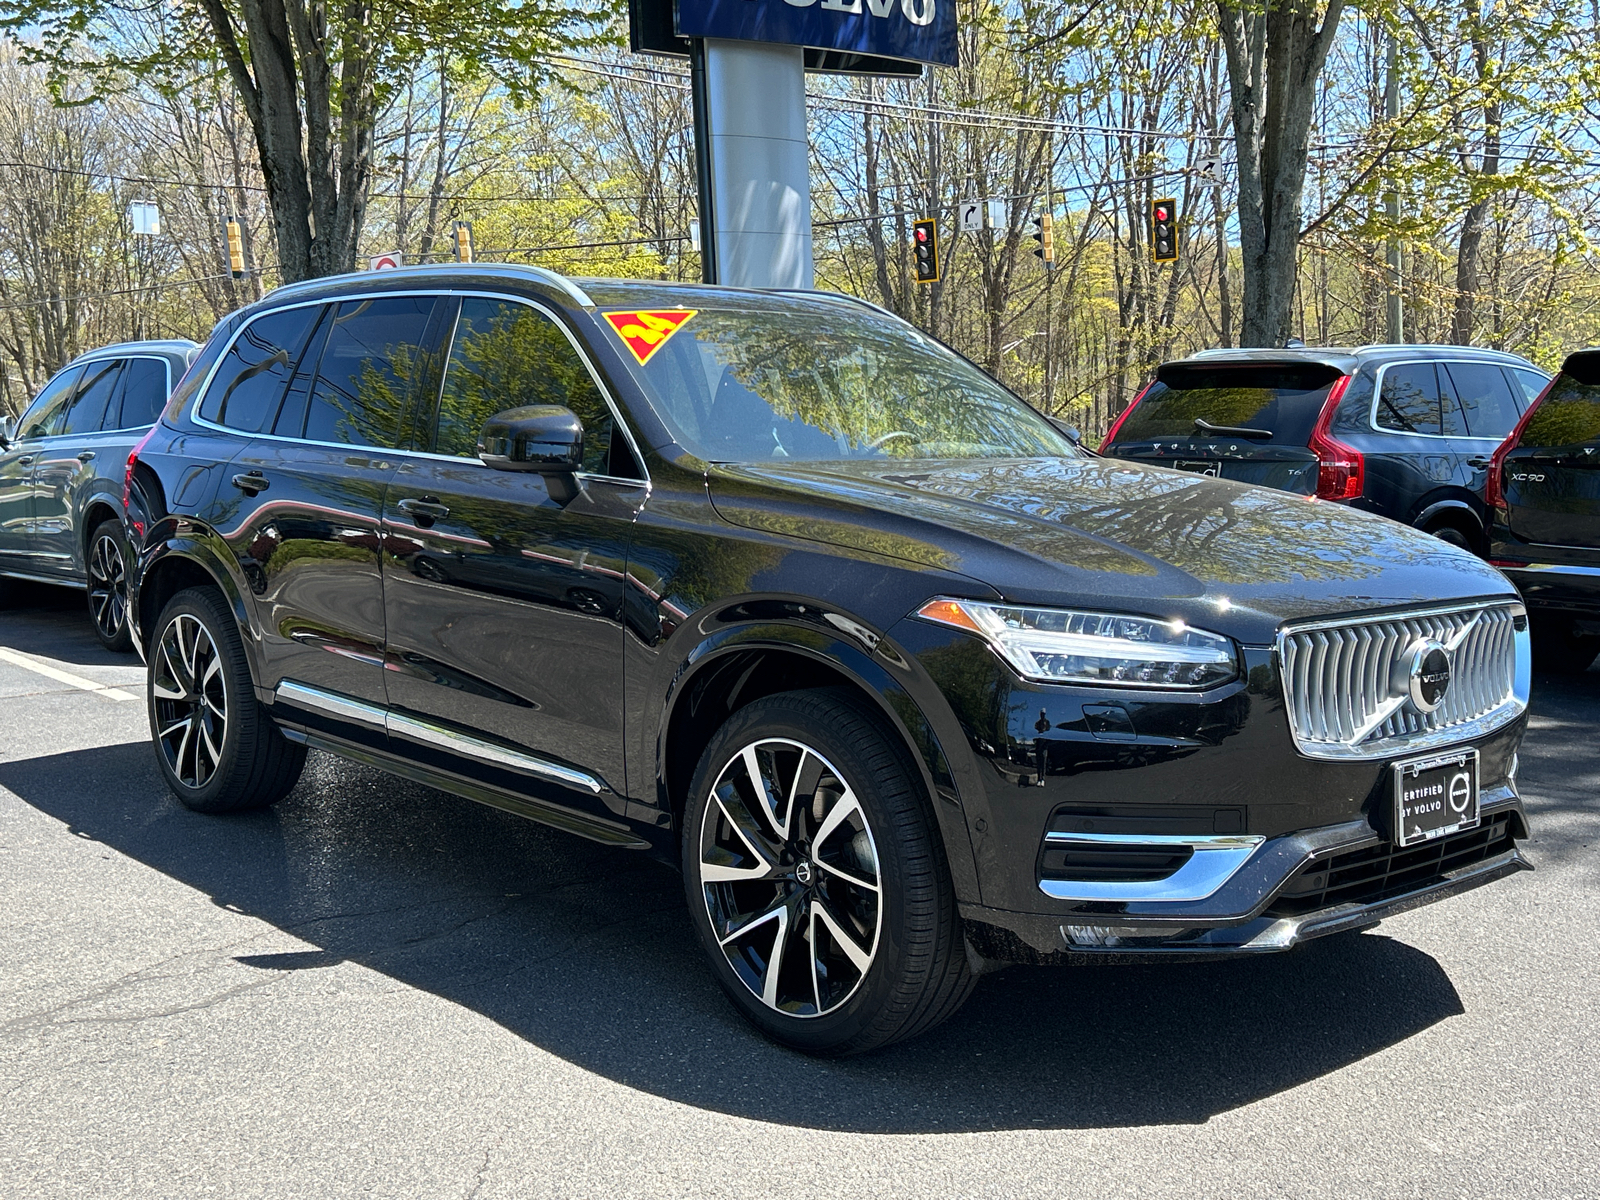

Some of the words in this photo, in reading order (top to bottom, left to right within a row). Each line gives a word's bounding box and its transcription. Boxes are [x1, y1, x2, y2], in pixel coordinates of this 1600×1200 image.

[964, 222, 979, 230] ONLY
[620, 313, 677, 345] 24
[1153, 443, 1238, 452] VOLVO
[1511, 473, 1546, 482] XC90
[1422, 672, 1449, 683] VOLVO
[1403, 784, 1443, 801] ERTIFIED
[1414, 801, 1441, 815] VOLVO
